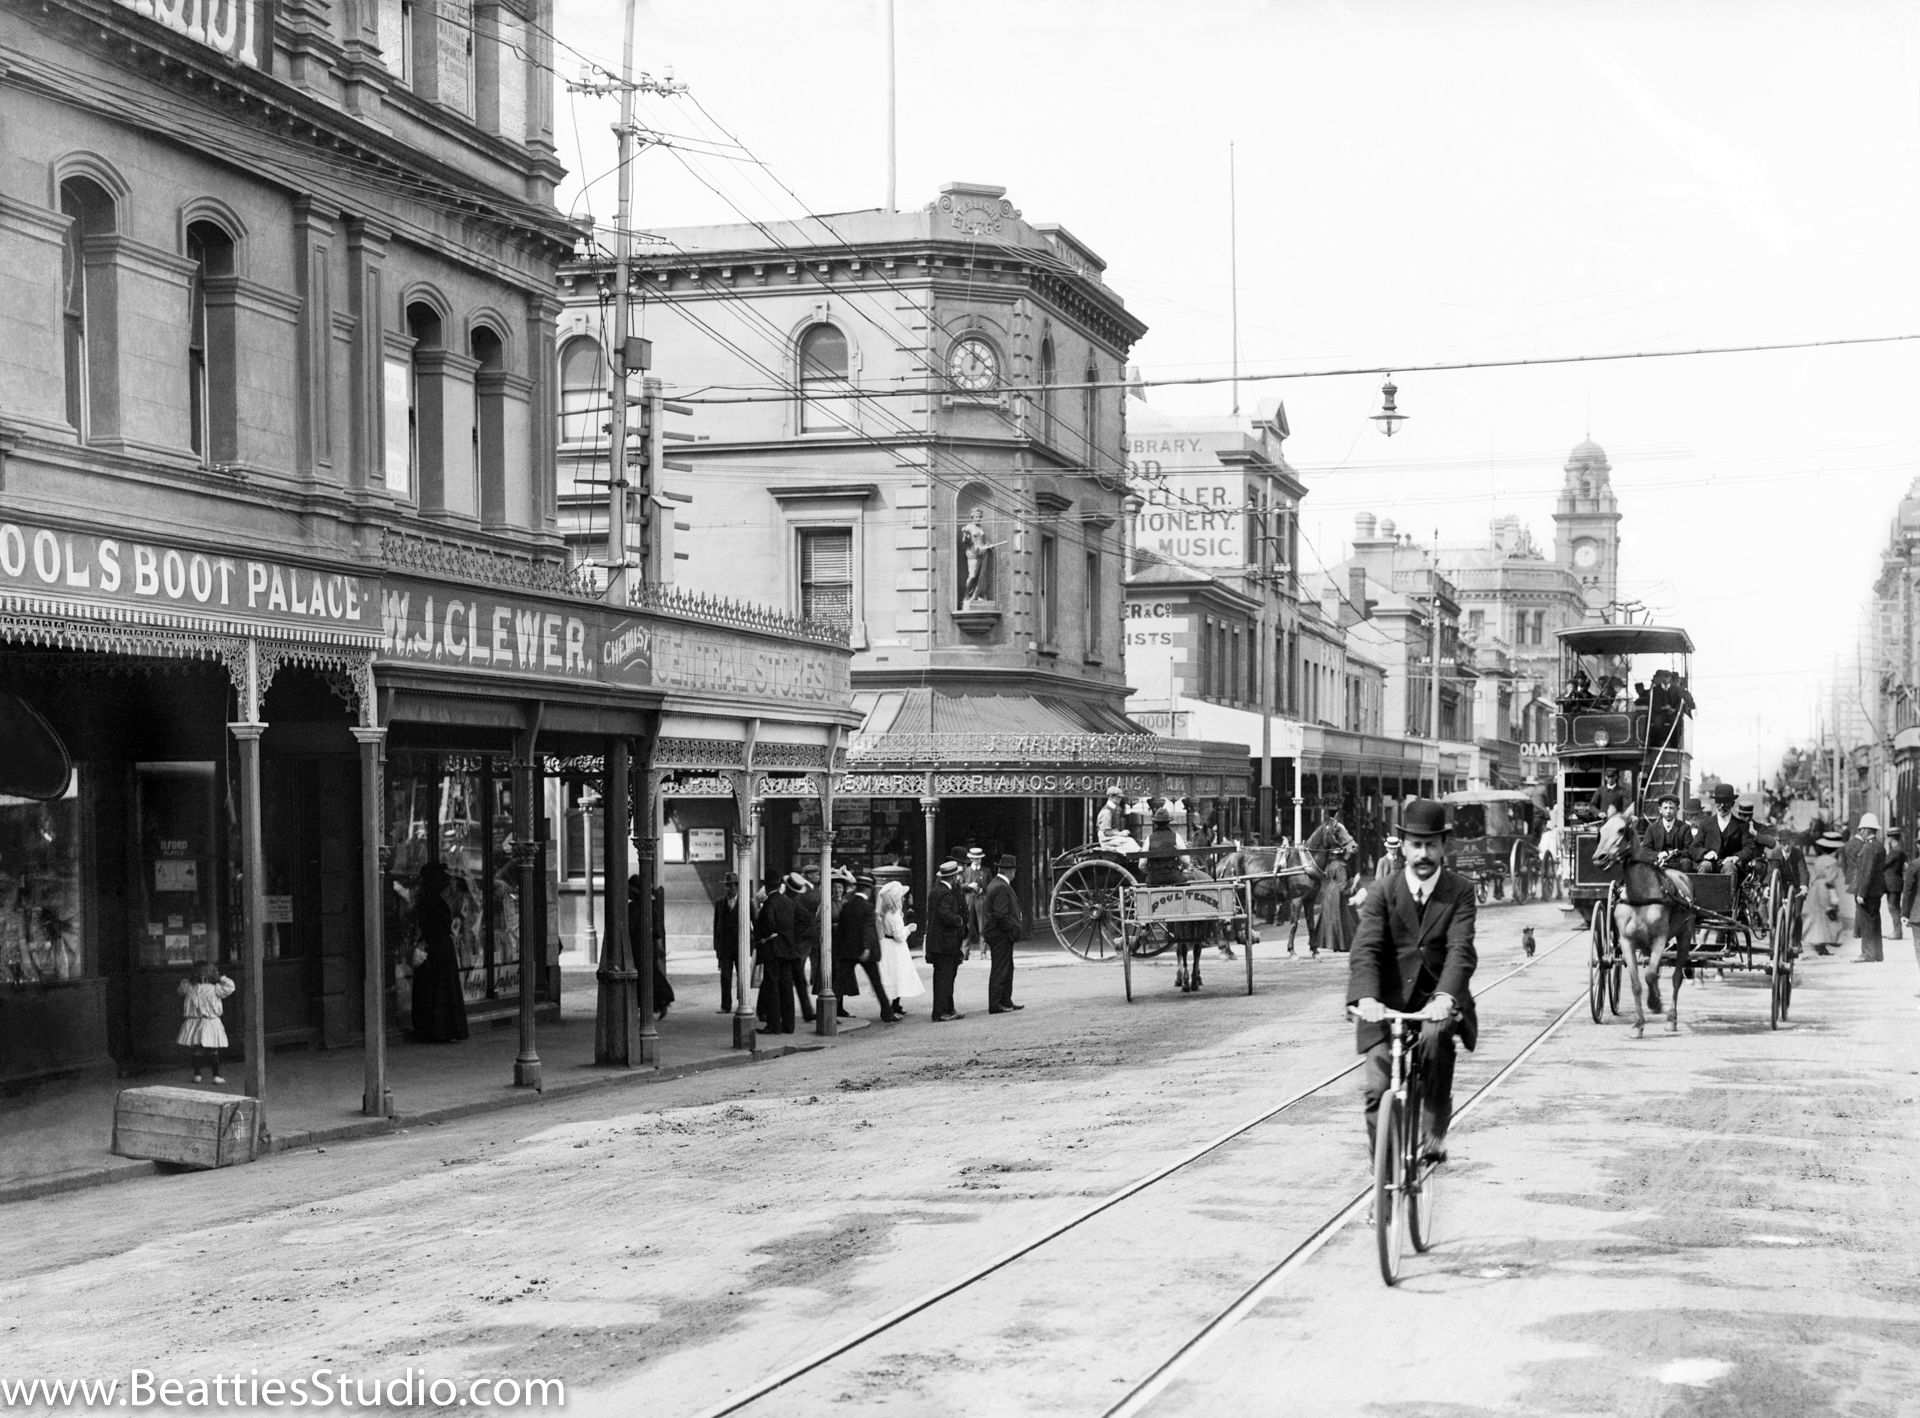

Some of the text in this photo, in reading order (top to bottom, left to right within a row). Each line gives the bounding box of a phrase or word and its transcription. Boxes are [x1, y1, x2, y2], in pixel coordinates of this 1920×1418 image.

[1158, 538, 1239, 556] MUSIC.
[132, 544, 236, 606] BOOT
[971, 775, 1057, 791] PIANOS
[1064, 775, 1075, 790] &
